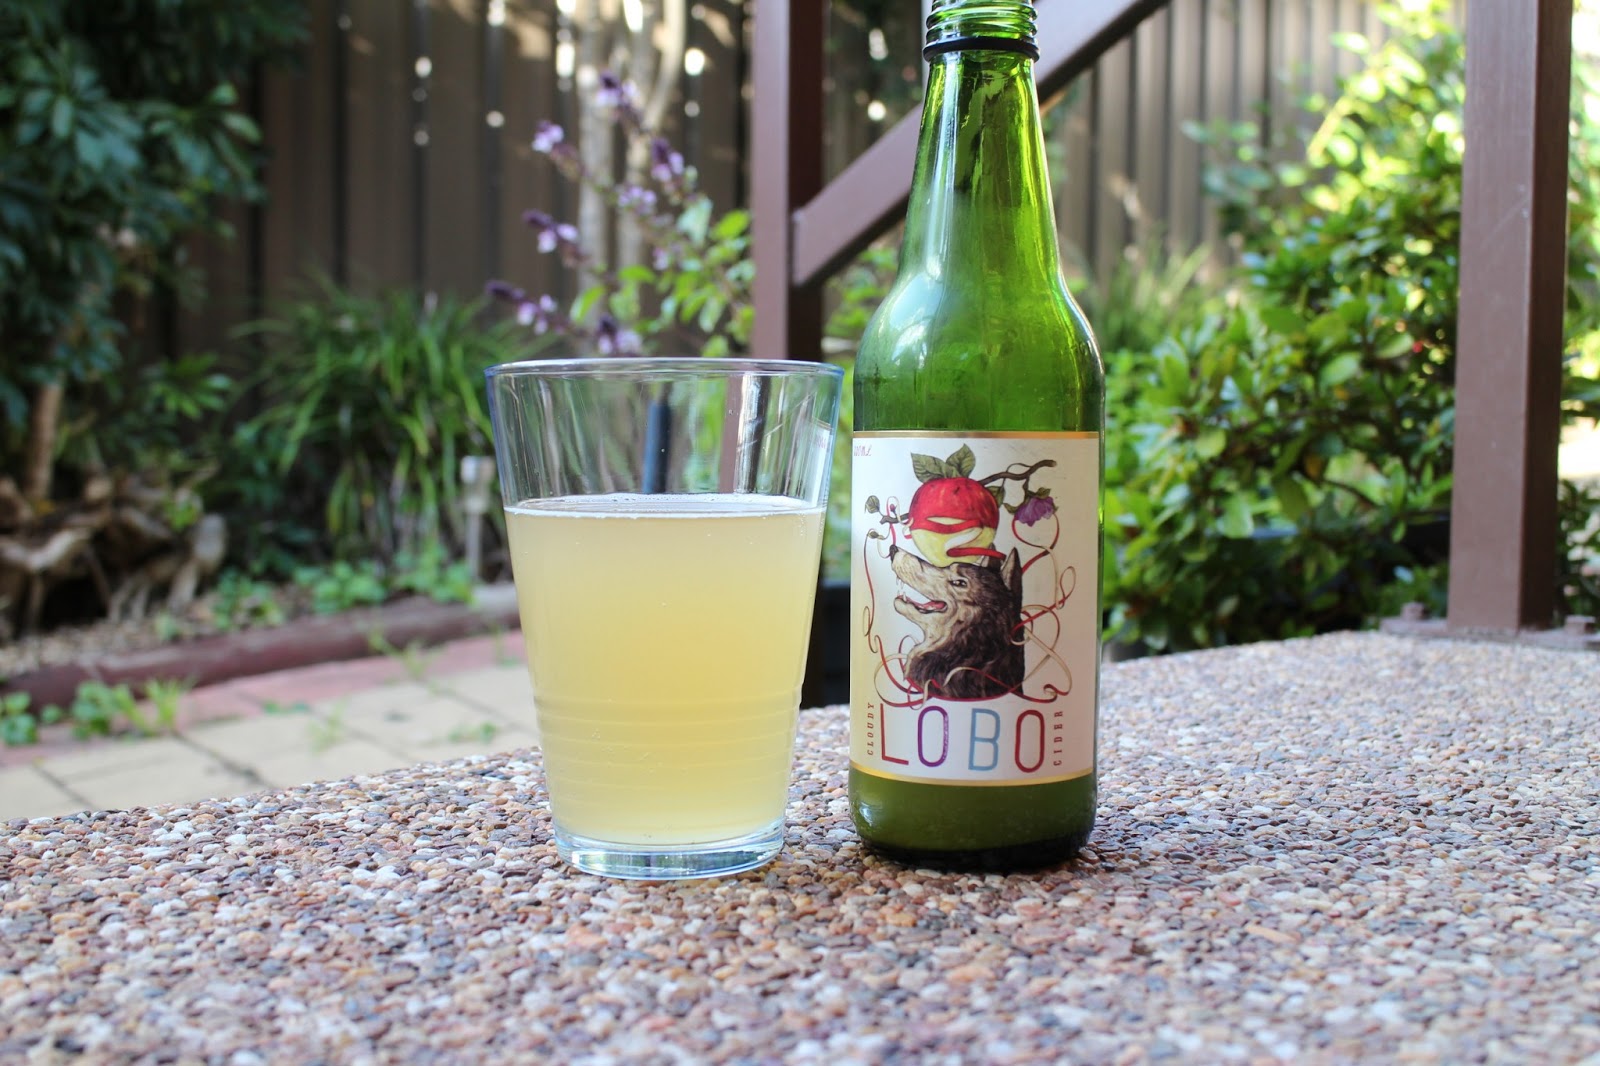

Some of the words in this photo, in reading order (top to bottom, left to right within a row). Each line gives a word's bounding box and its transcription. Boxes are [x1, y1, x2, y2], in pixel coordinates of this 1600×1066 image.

[866, 702, 875, 757] CLOUDY
[880, 703, 1046, 774] LOBO
[1053, 710, 1064, 767] CIDER
